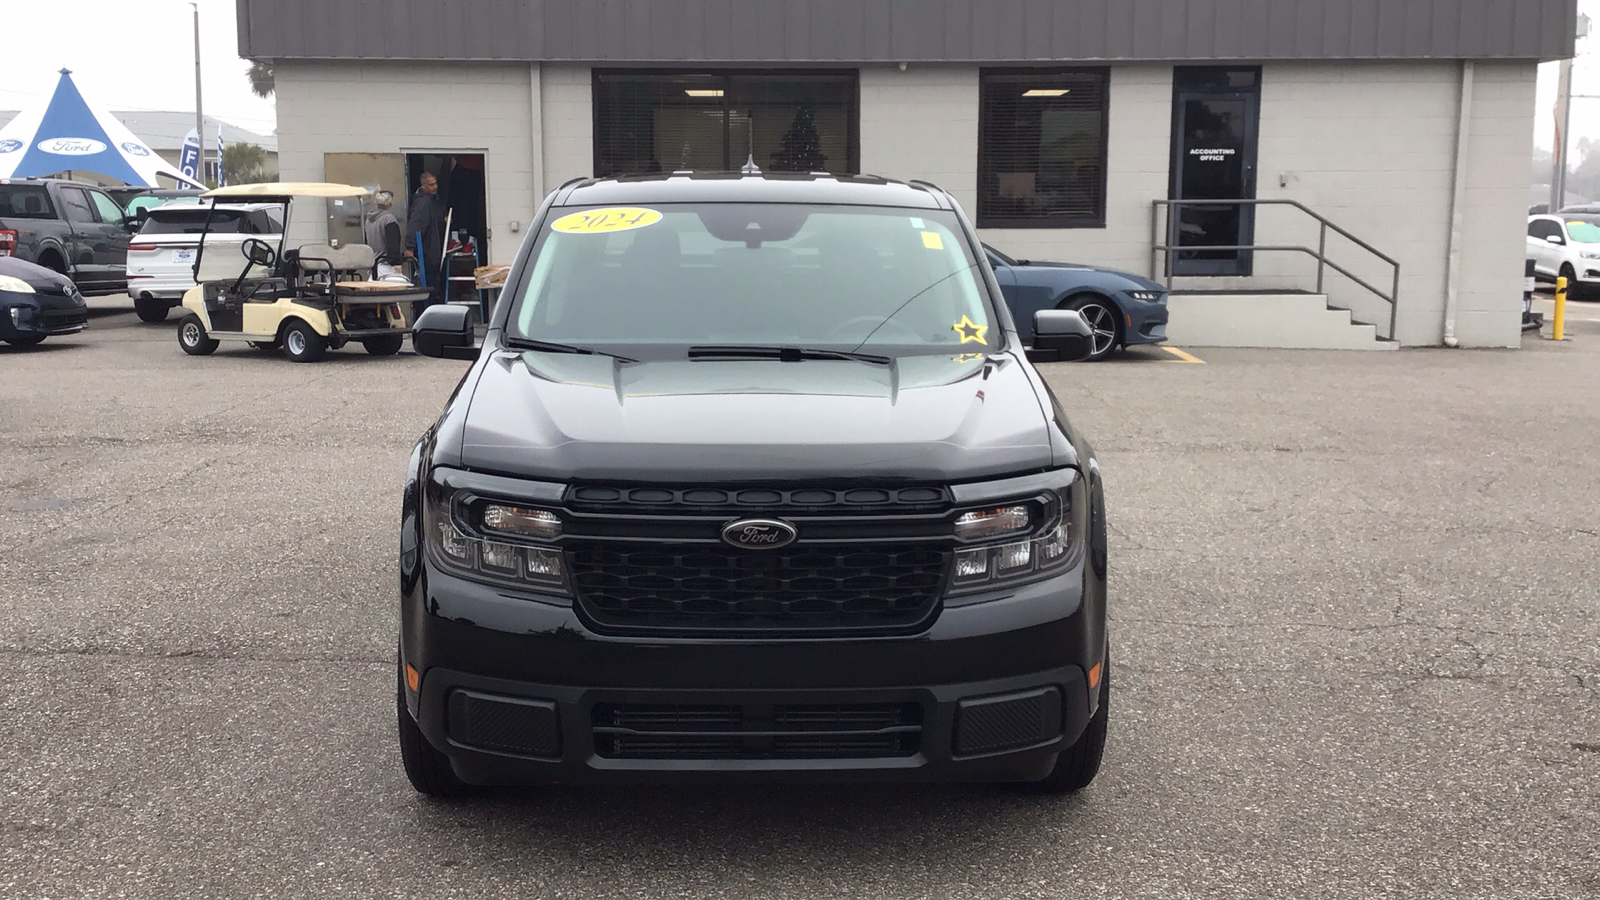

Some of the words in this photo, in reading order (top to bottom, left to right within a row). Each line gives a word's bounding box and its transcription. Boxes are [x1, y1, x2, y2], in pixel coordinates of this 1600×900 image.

[53, 140, 92, 152] Ford
[567, 211, 648, 231] 2024
[739, 525, 780, 543] Ford
